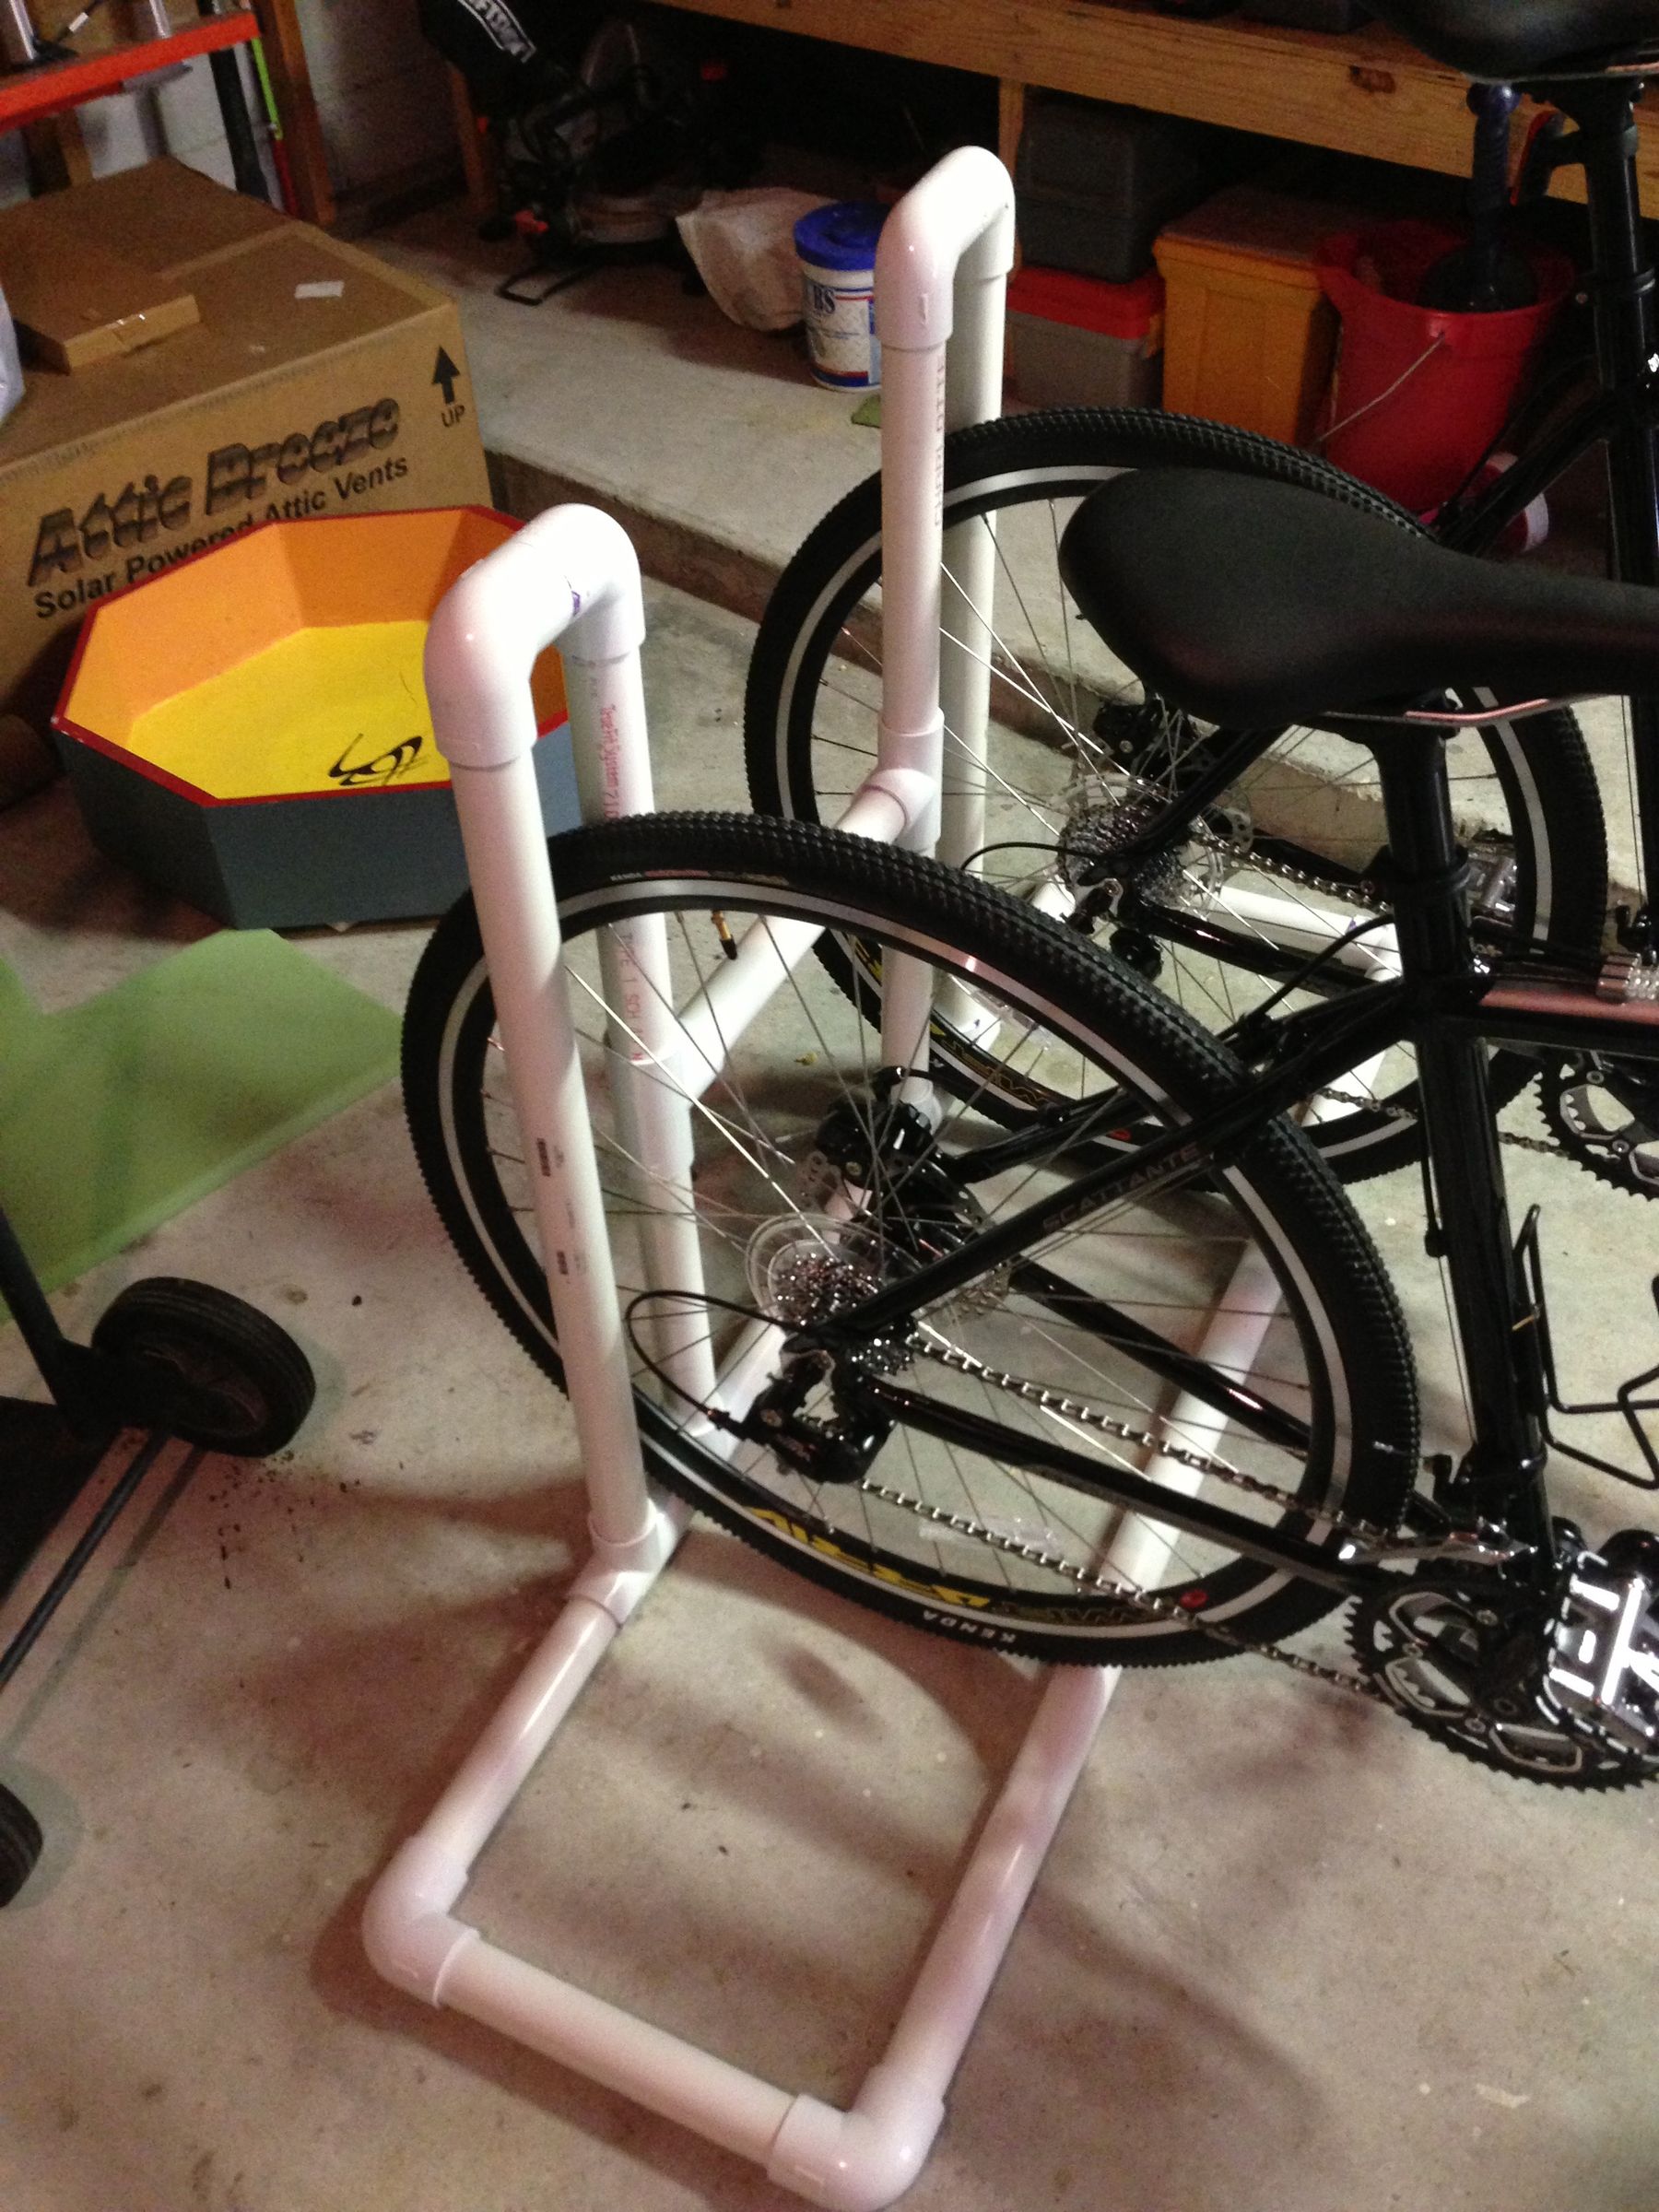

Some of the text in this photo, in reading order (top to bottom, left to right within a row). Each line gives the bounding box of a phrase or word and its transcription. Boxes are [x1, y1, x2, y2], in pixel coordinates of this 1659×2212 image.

[441, 406, 465, 429] UP
[28, 474, 193, 587] Attic
[33, 572, 115, 620] Solar
[333, 457, 408, 501] Vents
[922, 1609, 1018, 1645] KENDA
